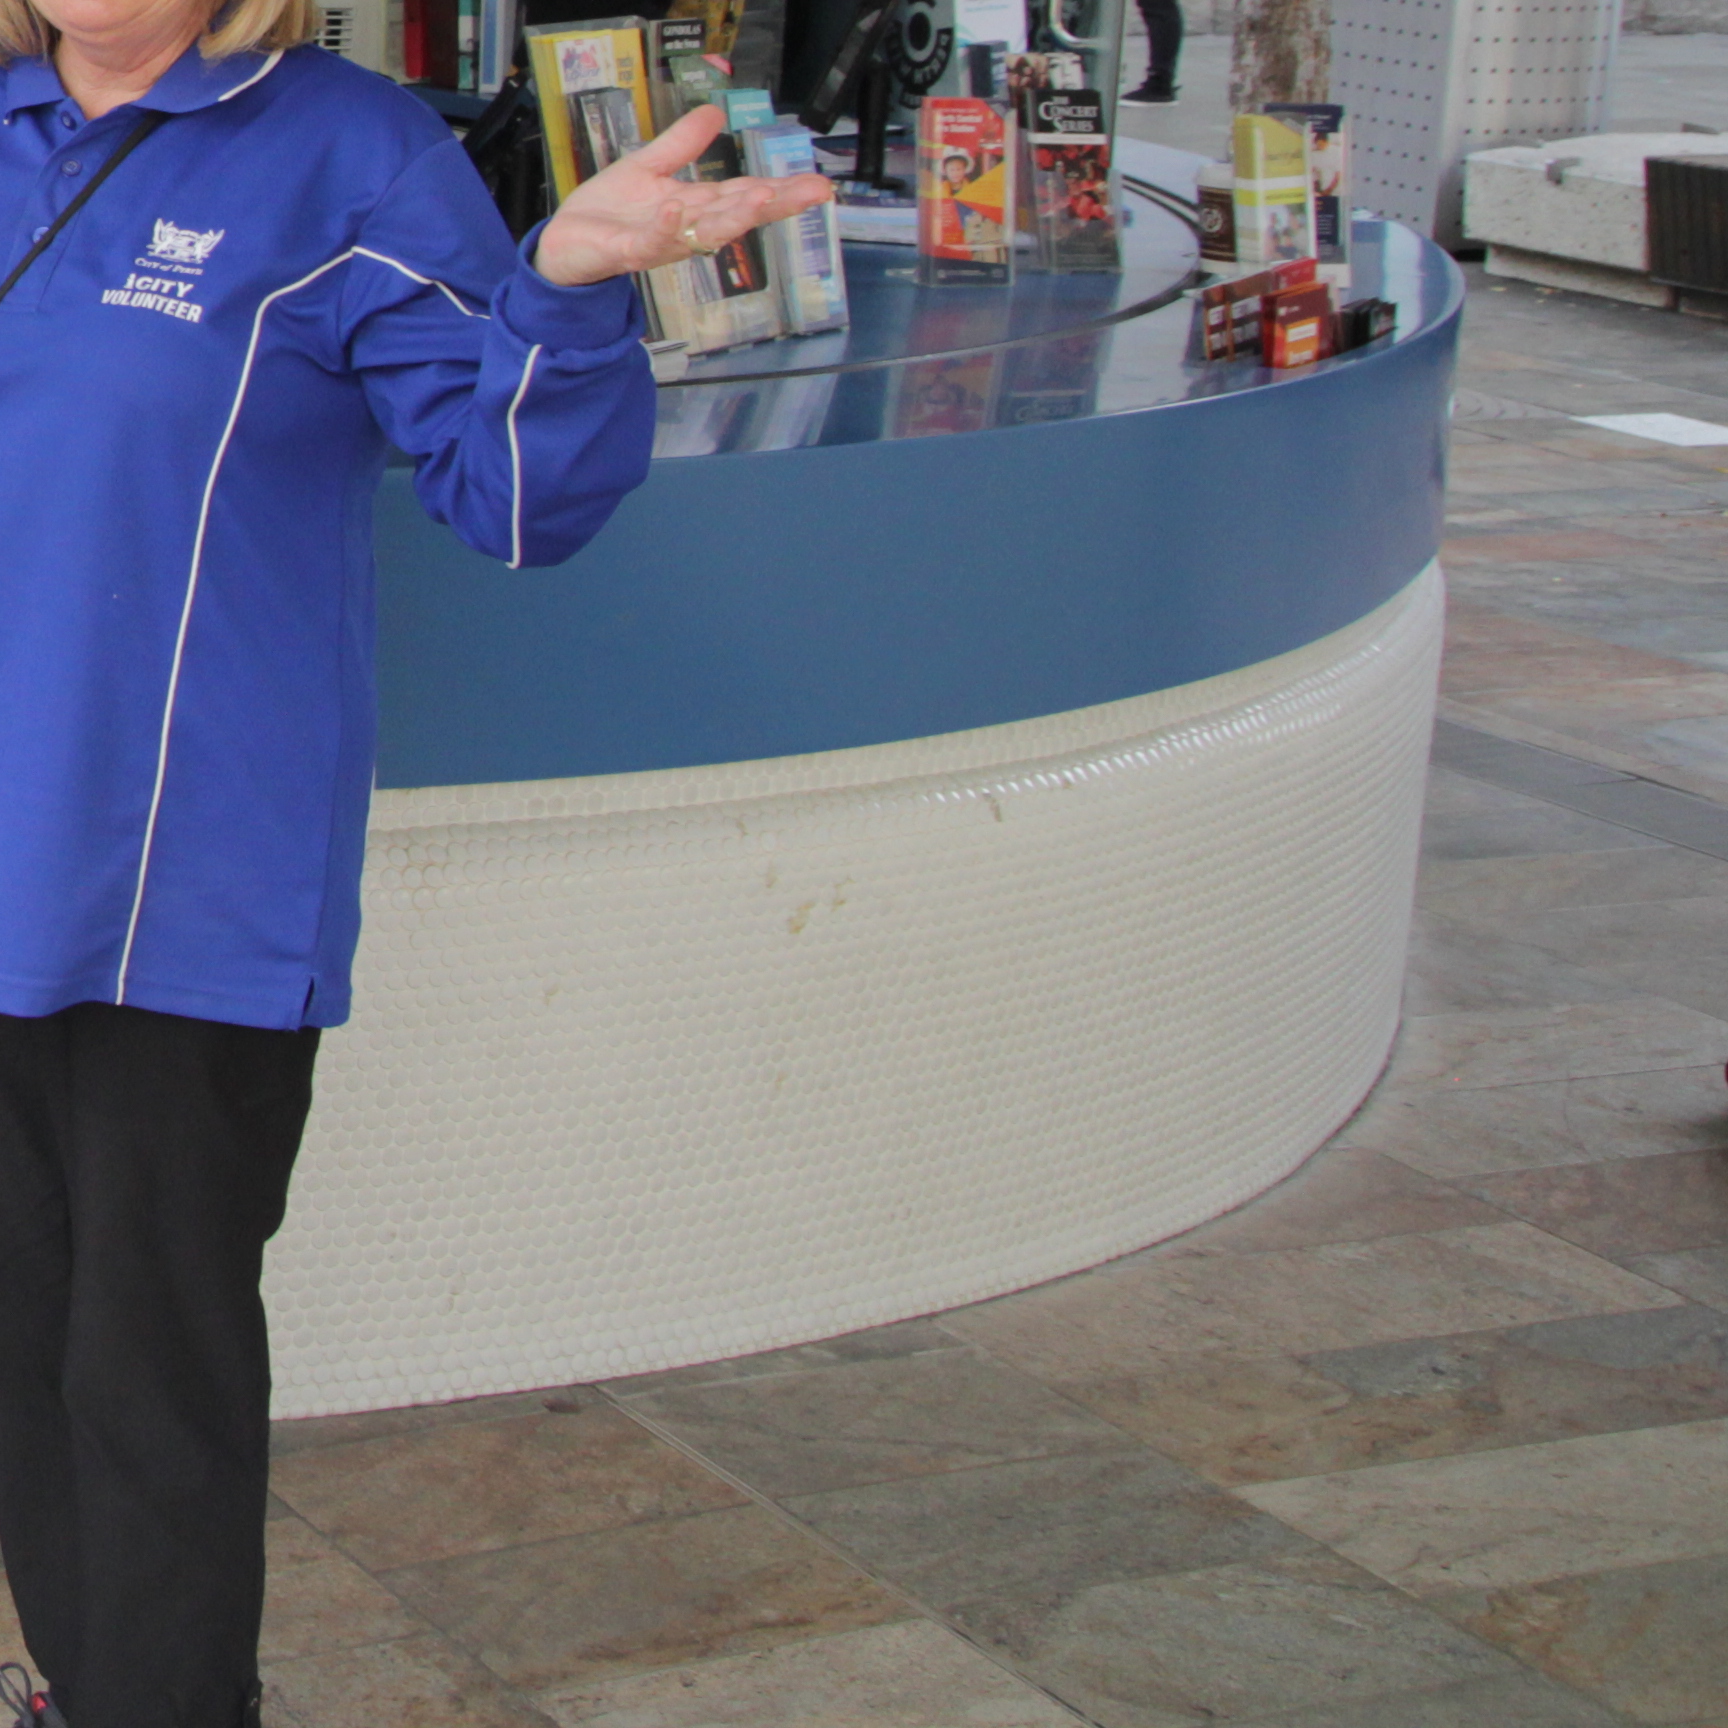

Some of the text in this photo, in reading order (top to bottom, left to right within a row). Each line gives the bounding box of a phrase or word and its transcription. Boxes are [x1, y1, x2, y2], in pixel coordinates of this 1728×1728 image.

[662, 24, 702, 36] GONDOLAS
[1038, 101, 1099, 121] CONCERT
[1052, 117, 1095, 133] SERIES
[100, 288, 204, 324] VOLUNTEER
